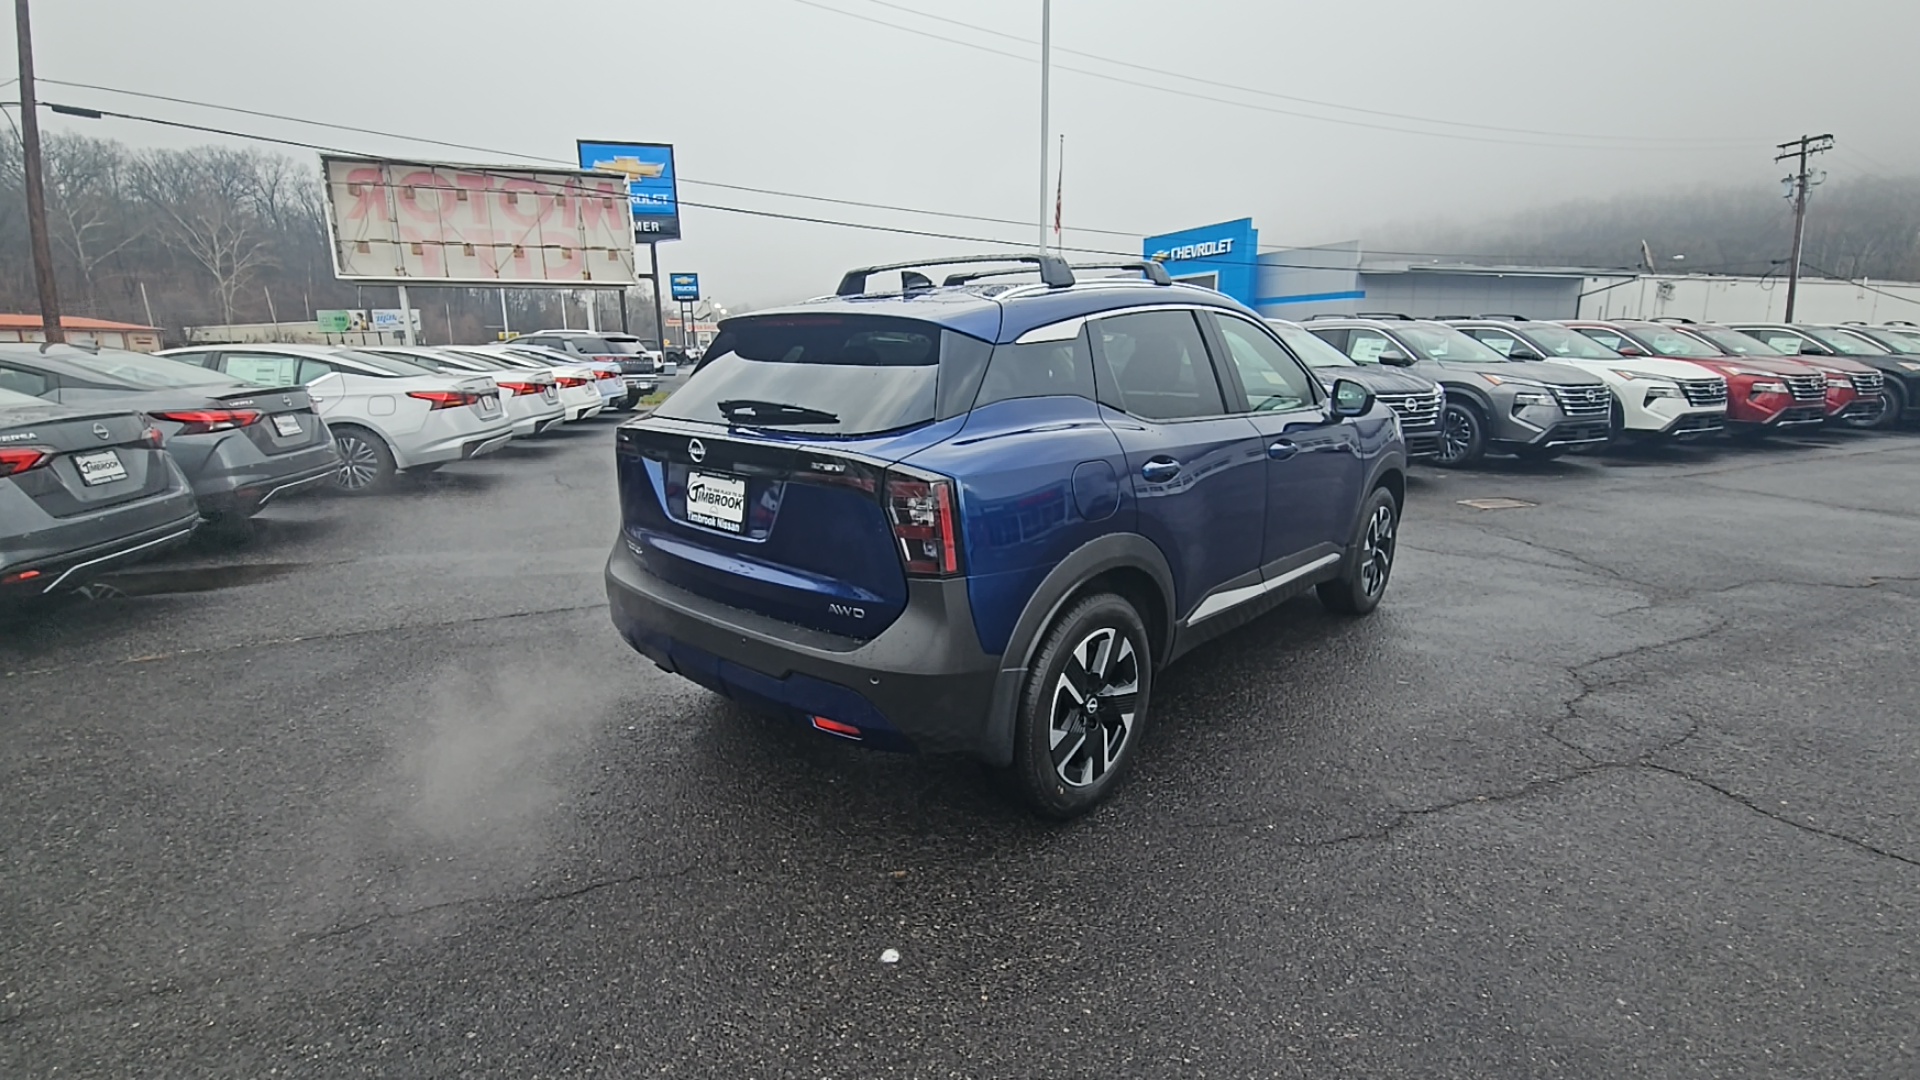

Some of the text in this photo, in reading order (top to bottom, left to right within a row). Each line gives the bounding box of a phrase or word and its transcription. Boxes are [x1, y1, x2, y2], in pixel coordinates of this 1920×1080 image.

[1170, 238, 1234, 261] CHEVROLET
[687, 481, 743, 510] TIMBROOK
[688, 511, 740, 533] Timbrook Nissan
[828, 603, 866, 619] AWD
